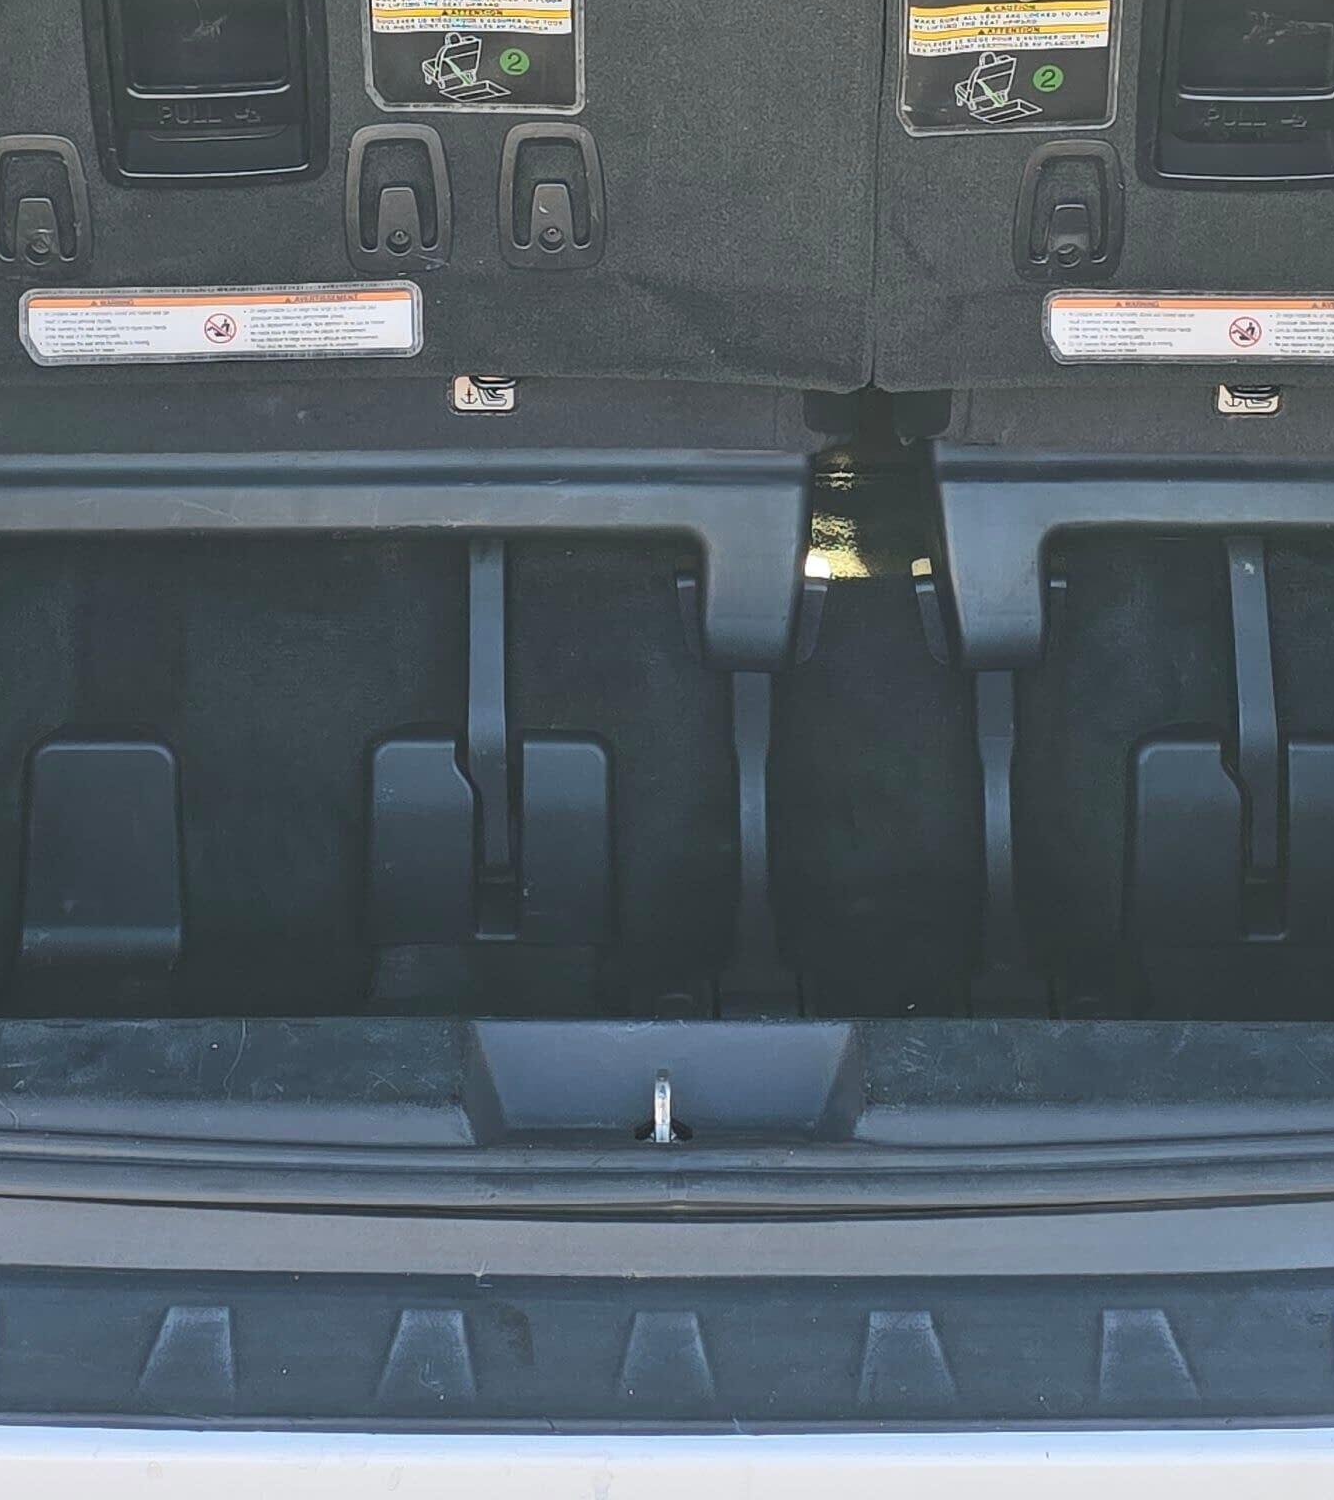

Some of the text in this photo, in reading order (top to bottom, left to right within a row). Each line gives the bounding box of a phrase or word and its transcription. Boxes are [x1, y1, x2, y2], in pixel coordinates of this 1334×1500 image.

[994, 4, 1035, 12] CAUTION
[507, 52, 524, 72] 2
[1040, 69, 1056, 88] 2
[157, 104, 222, 125] PULL
